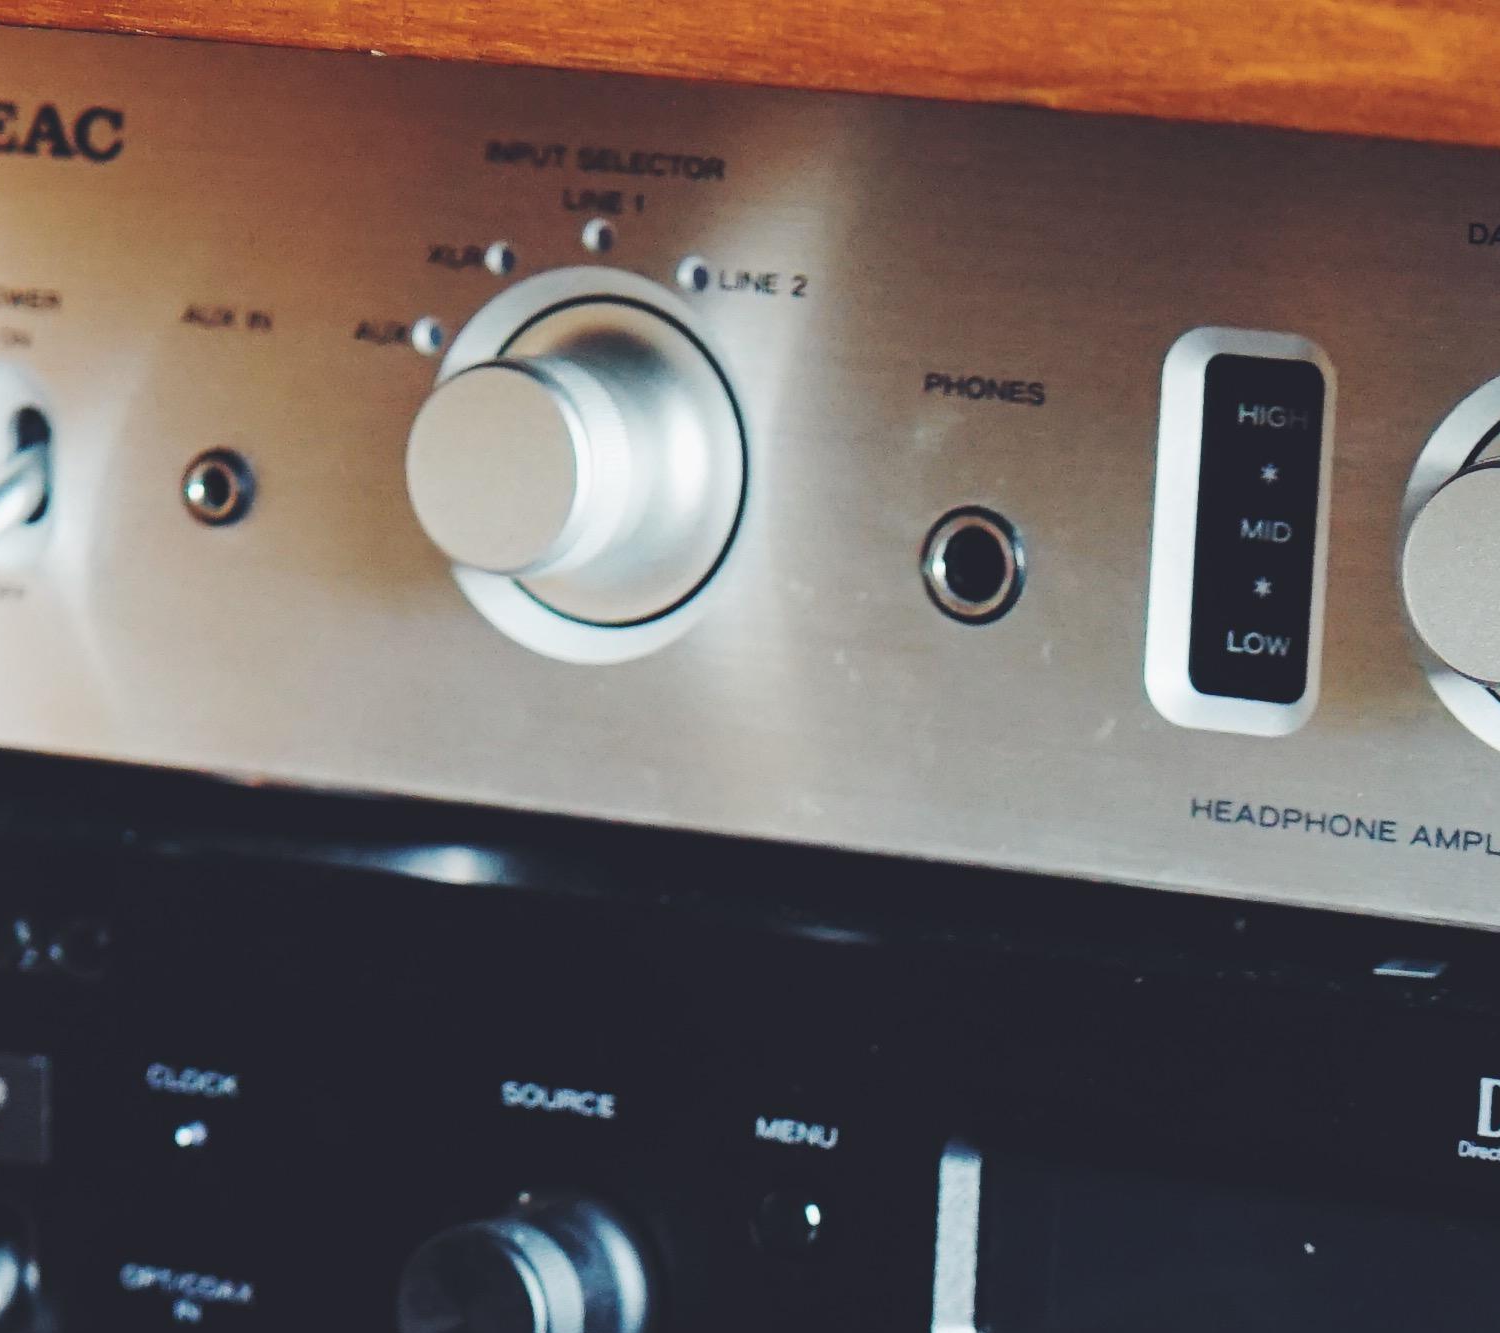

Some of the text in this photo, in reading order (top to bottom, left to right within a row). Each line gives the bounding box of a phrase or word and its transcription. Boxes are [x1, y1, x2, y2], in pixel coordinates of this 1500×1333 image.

[485, 141, 727, 181] INPUT SELECTOR
[562, 190, 622, 214] LINE
[719, 270, 807, 298] LINE 2
[181, 303, 236, 329] AUX
[923, 372, 1046, 406] PHONES
[1238, 403, 1309, 430] HIGH
[1240, 517, 1293, 543] MID
[1226, 629, 1292, 656] LOW
[1190, 798, 1398, 842] HEADPHONE
[145, 1062, 238, 1097] CLOCK
[501, 1079, 617, 1120] SOURCE
[755, 1114, 840, 1150] MENU
